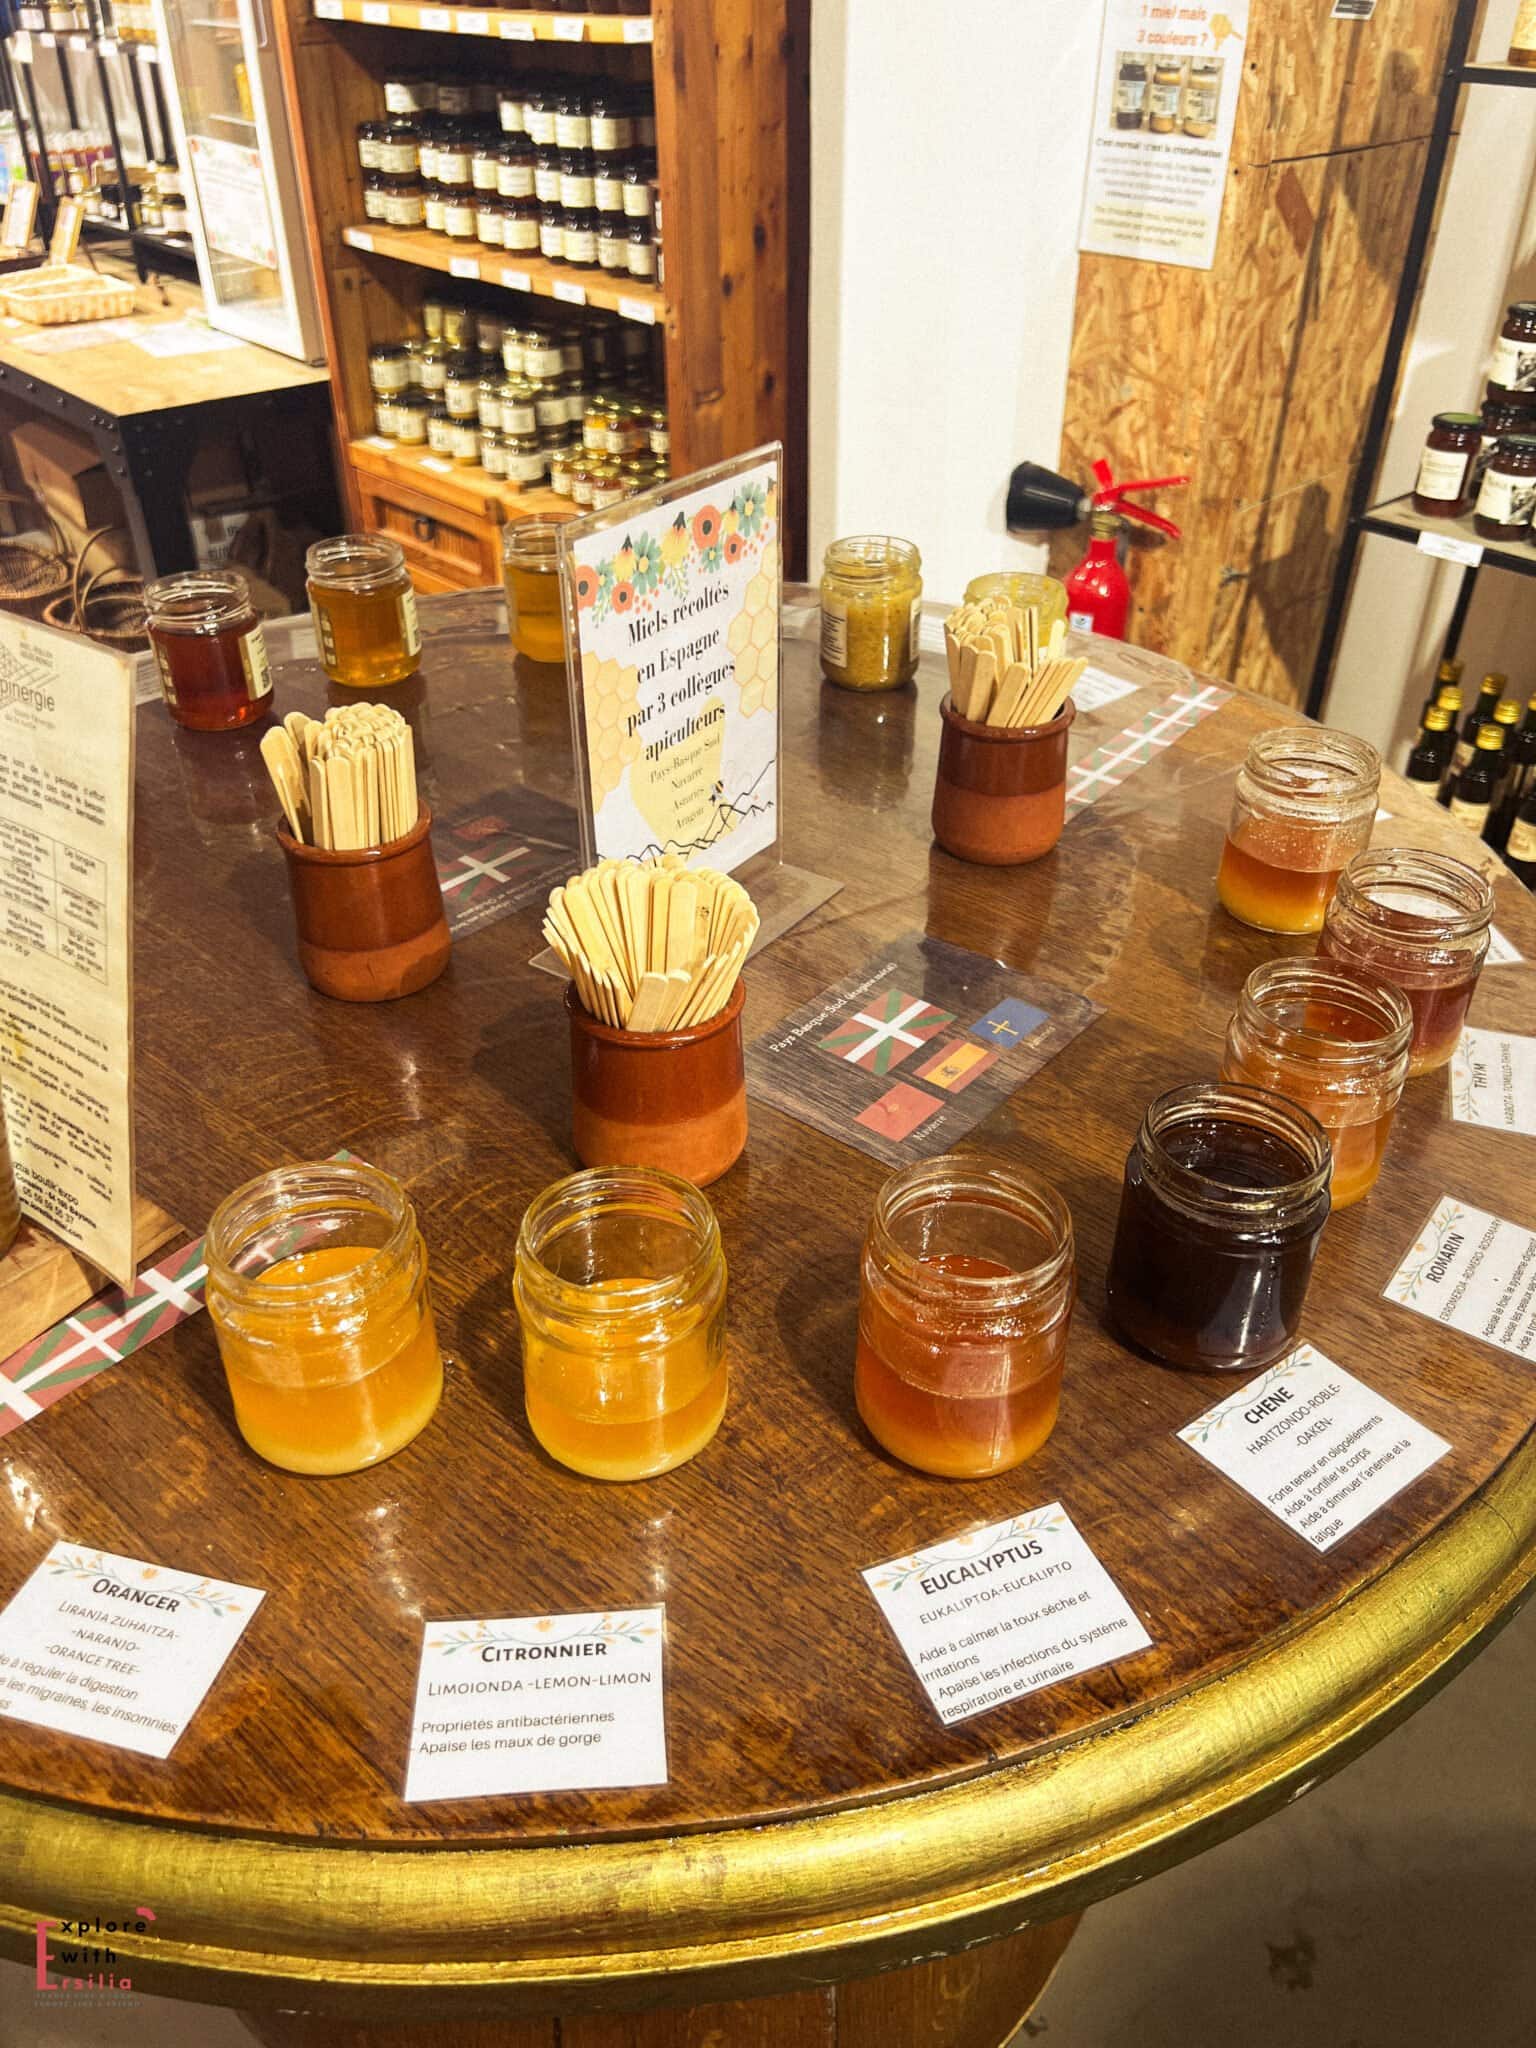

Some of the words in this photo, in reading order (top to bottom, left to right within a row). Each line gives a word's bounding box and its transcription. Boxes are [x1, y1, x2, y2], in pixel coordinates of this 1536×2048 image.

[1148, 32, 1198, 46] couleurs
[629, 610, 668, 648] Miels
[673, 580, 729, 624] récoltés
[637, 663, 655, 684] en
[660, 629, 720, 672] Espagne
[627, 704, 654, 738] par
[658, 692, 666, 713] 3
[670, 660, 735, 707] collègues
[645, 703, 725, 762] apiculteurs
[769, 1031, 797, 1053] Pays
[796, 1007, 829, 1037] Basque
[825, 994, 848, 1015] Sud
[1472, 1063, 1488, 1089] THYM
[1426, 1232, 1465, 1284] ROMARIN
[1267, 1483, 1294, 1505] Forte
[1290, 1463, 1320, 1490] teneur
[1317, 1454, 1332, 1468] en
[1283, 1498, 1307, 1517] Aide
[1308, 1471, 1342, 1497] fortifier
[1339, 1462, 1349, 1475] le
[1346, 1447, 1372, 1469] corps
[1299, 1510, 1322, 1530] Aide
[1326, 1479, 1363, 1510] diminuer
[1391, 1446, 1403, 1457] et
[1401, 1437, 1412, 1449] la
[1309, 1518, 1345, 1547] fatigue
[919, 1539, 1043, 1596] EUCALYPTUS
[92, 1578, 181, 1613] ORANGER
[918, 1643, 948, 1664] Aide
[958, 1625, 999, 1650] calmer
[1001, 1620, 1013, 1634] la
[1012, 1610, 1041, 1628] toux
[1078, 1589, 1092, 1604] et
[481, 1642, 608, 1664] CITRONNIER
[922, 1654, 981, 1683] irritations
[937, 1676, 981, 1701] Apaise
[981, 1668, 1001, 1683] les
[1001, 1643, 1060, 1675] infections
[1061, 1638, 1079, 1652] du
[1079, 1618, 1128, 1646] système
[6, 1679, 26, 1693] les
[91, 1700, 111, 1717] les
[67, 1669, 79, 1685] la
[79, 1674, 140, 1702] digestion
[941, 1685, 1012, 1720] respiratoire
[1013, 1677, 1027, 1692] et
[1027, 1660, 1075, 1688] urinaire
[419, 1740, 468, 1756] Apaise
[471, 1737, 492, 1752] les
[493, 1734, 534, 1750] maux
[536, 1733, 556, 1747] de
[558, 1731, 602, 1750] gorge
[496, 1710, 616, 1731] antibactériennes
